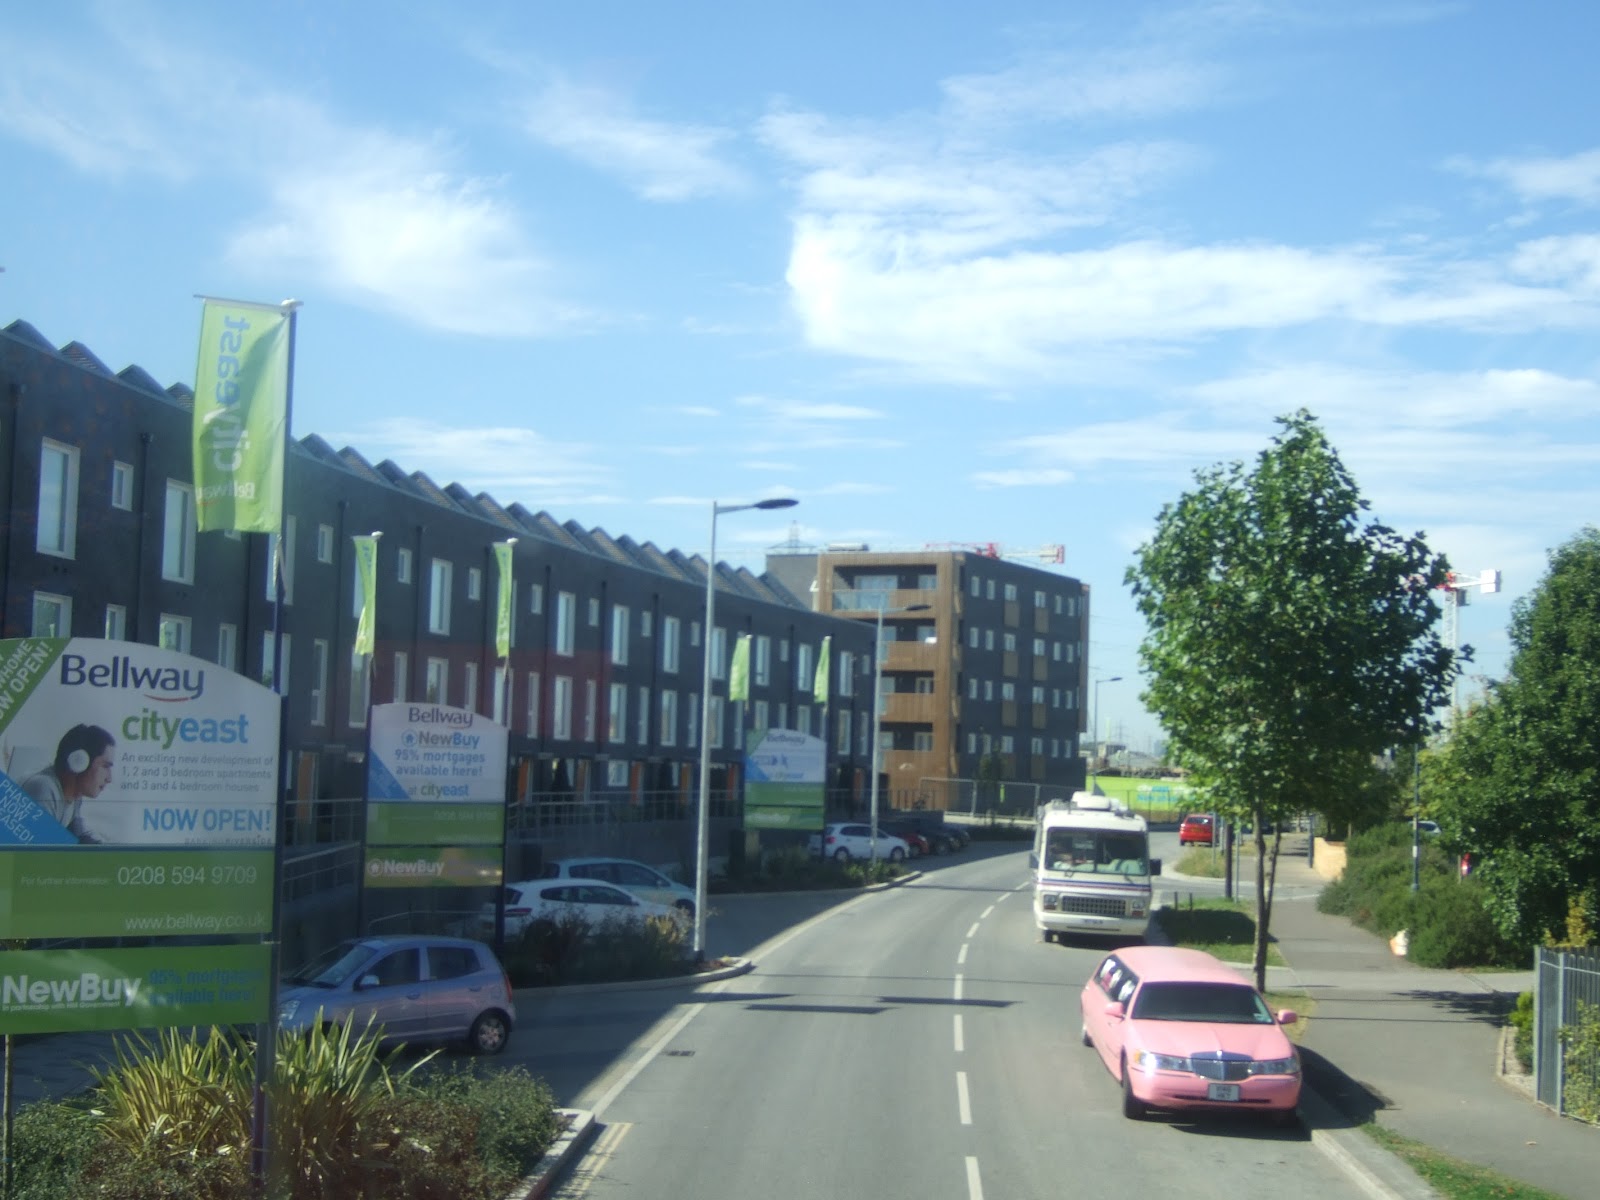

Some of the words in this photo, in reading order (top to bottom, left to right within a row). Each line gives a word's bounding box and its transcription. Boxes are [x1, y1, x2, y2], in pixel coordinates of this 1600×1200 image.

[9, 639, 53, 693] OPEN!
[60, 654, 204, 699] Bellway
[408, 706, 473, 728] Bellway
[122, 708, 249, 750] cityeast
[418, 731, 480, 749] NewBuy
[121, 752, 135, 762] An
[138, 753, 176, 766] exciting
[178, 755, 198, 764] new
[201, 755, 262, 766] development
[423, 750, 486, 765] mortgages
[132, 766, 139, 776] 2
[141, 766, 160, 777] and
[162, 766, 169, 777] 3
[171, 767, 214, 778] bedroom
[217, 769, 272, 779] apartments
[396, 764, 448, 777] available
[452, 765, 483, 777] here!
[120, 780, 139, 790] and
[141, 780, 148, 790] 3
[150, 780, 169, 791] and
[171, 781, 177, 791] 4
[179, 781, 222, 792] bedroom
[420, 783, 469, 799] cityeast
[0, 778, 37, 815] PHASE
[32, 809, 44, 820] 2
[0, 795, 30, 821] NOW
[143, 808, 198, 831] NOW
[202, 808, 271, 831] OPEN!
[117, 866, 165, 885] 0208
[171, 866, 205, 885] 594
[211, 866, 257, 885] 9709
[384, 859, 446, 877] NewBuy
[125, 913, 266, 930] www.bellway.co.uk
[2, 973, 142, 1007] NewBuy
